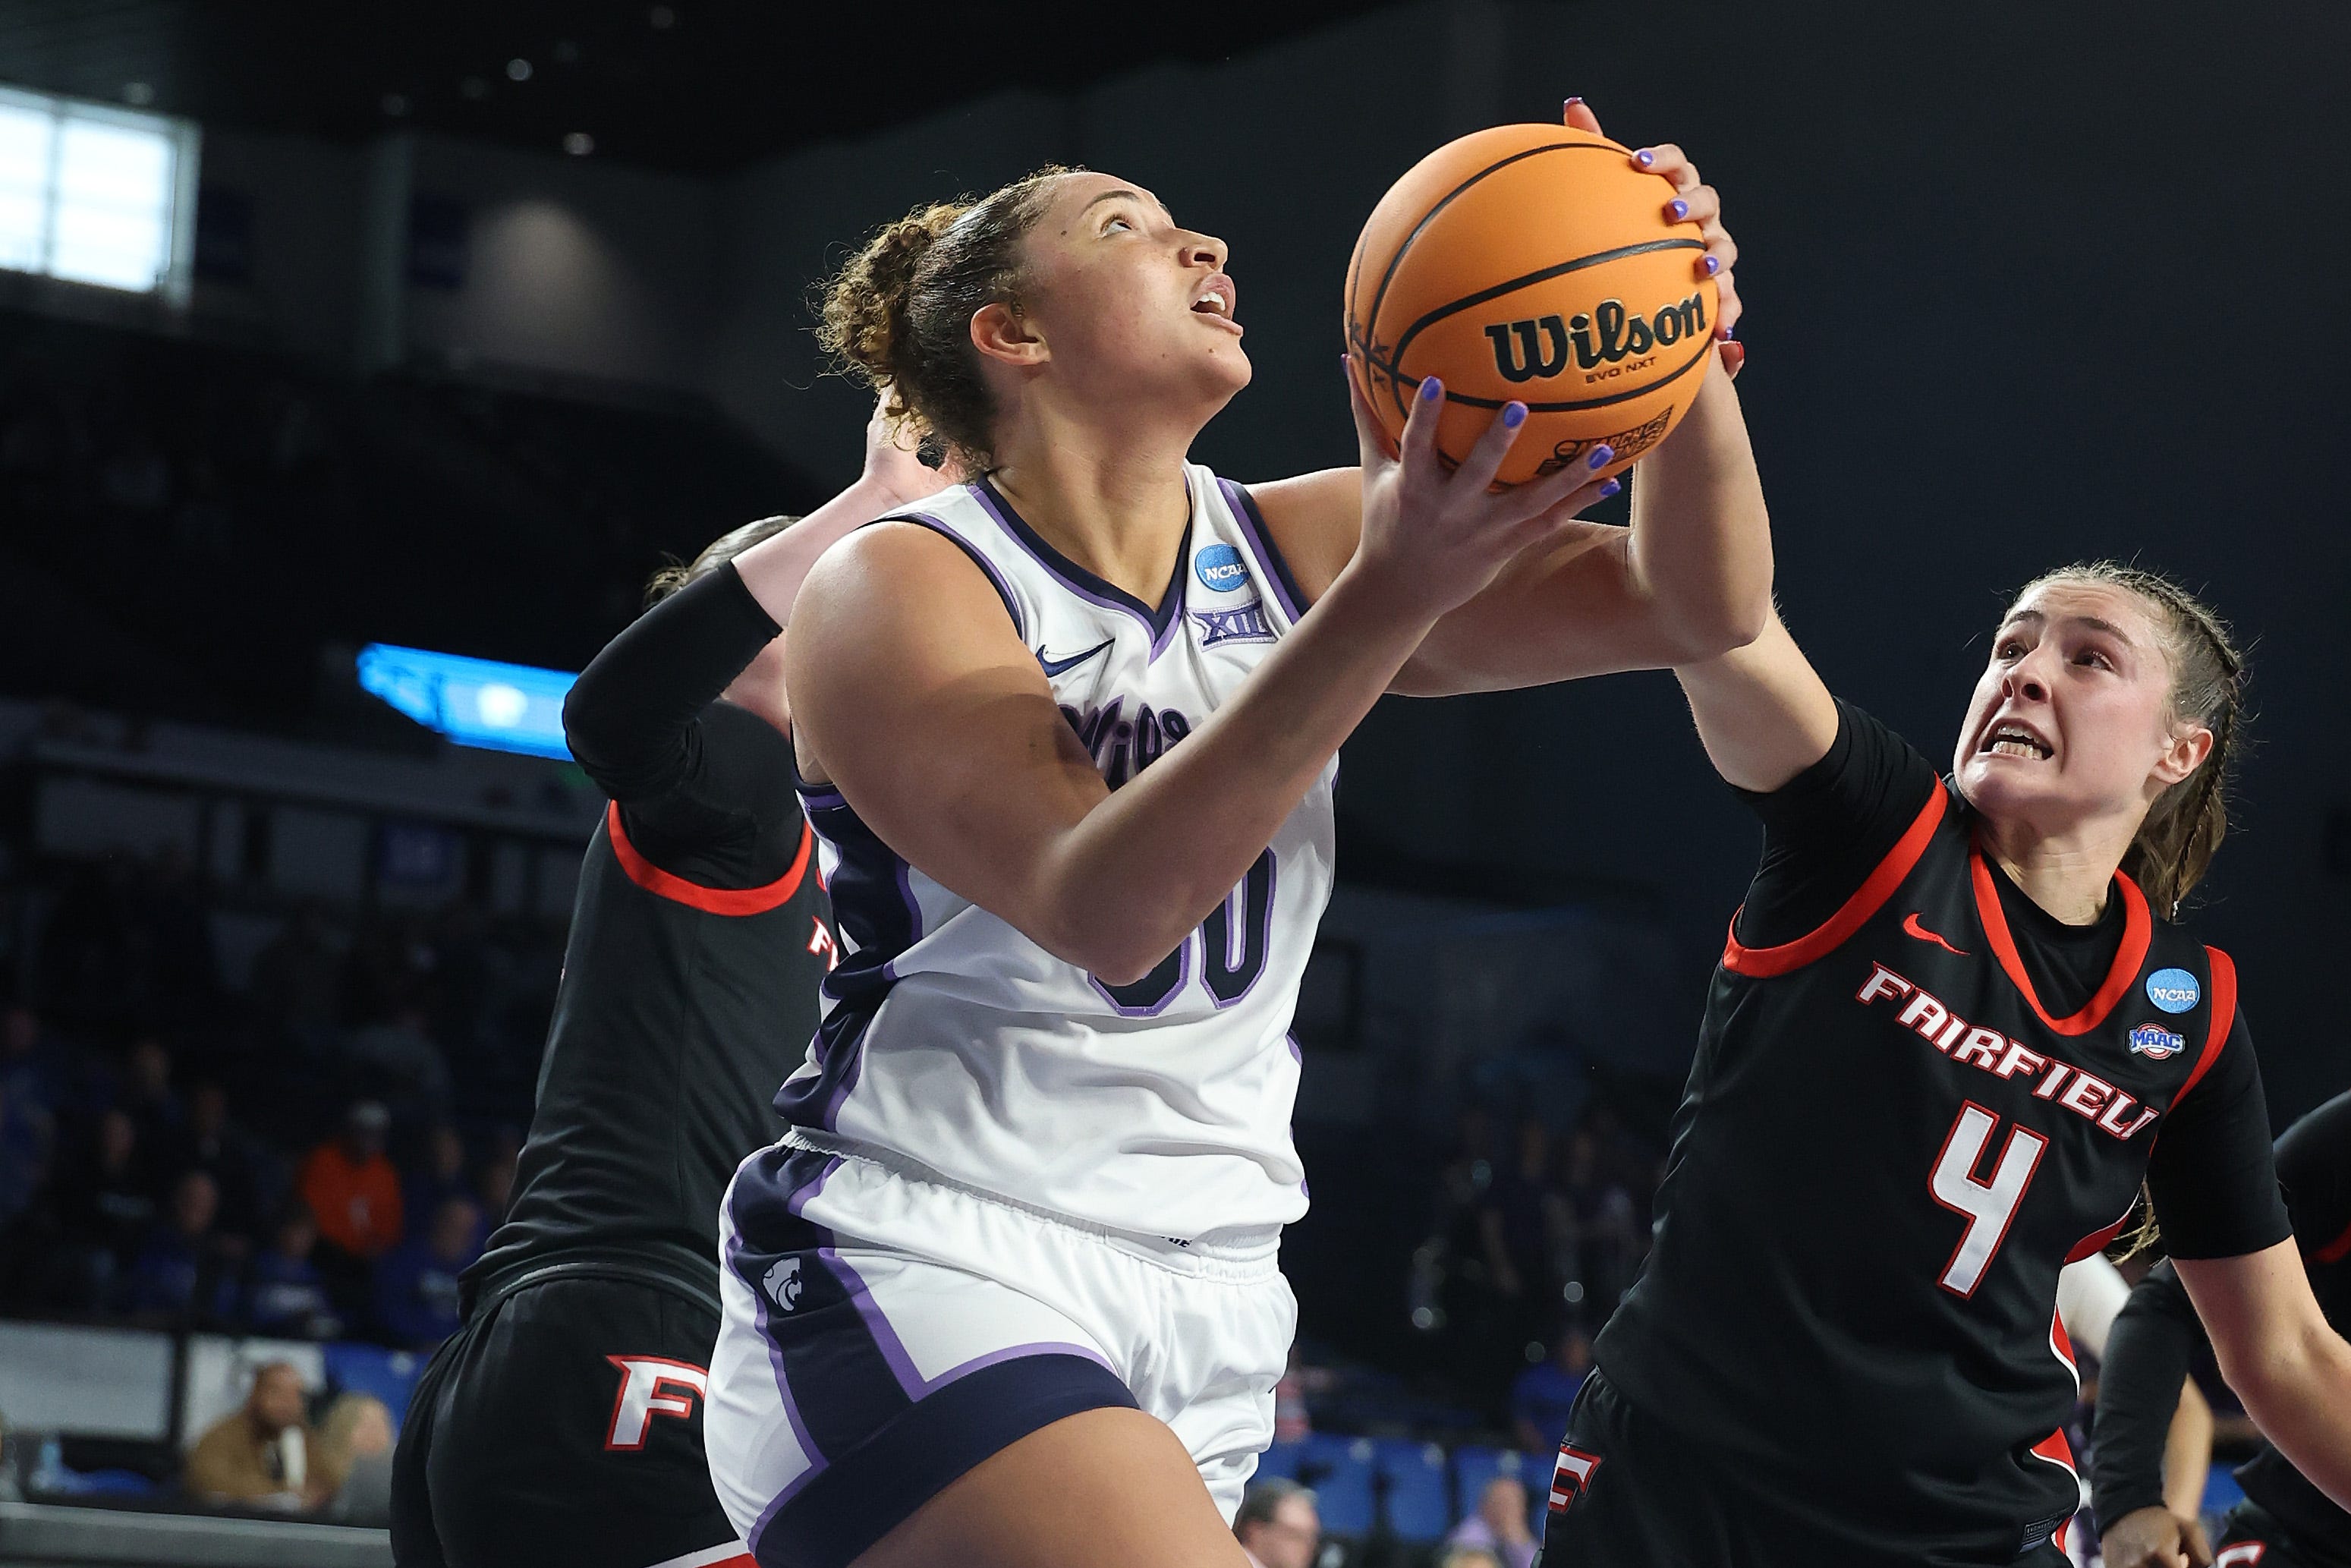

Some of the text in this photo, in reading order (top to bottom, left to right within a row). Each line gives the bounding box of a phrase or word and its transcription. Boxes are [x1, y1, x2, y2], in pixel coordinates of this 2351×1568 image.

[1484, 291, 1705, 383] Wilson
[1585, 356, 1657, 384] EVO NXT
[1087, 845, 1277, 1018] 0
[2130, 1030, 2183, 1050] MAAC
[2153, 987, 2197, 1002] NCAA
[1928, 1099, 2049, 1300] 4
[606, 1355, 709, 1451] F
